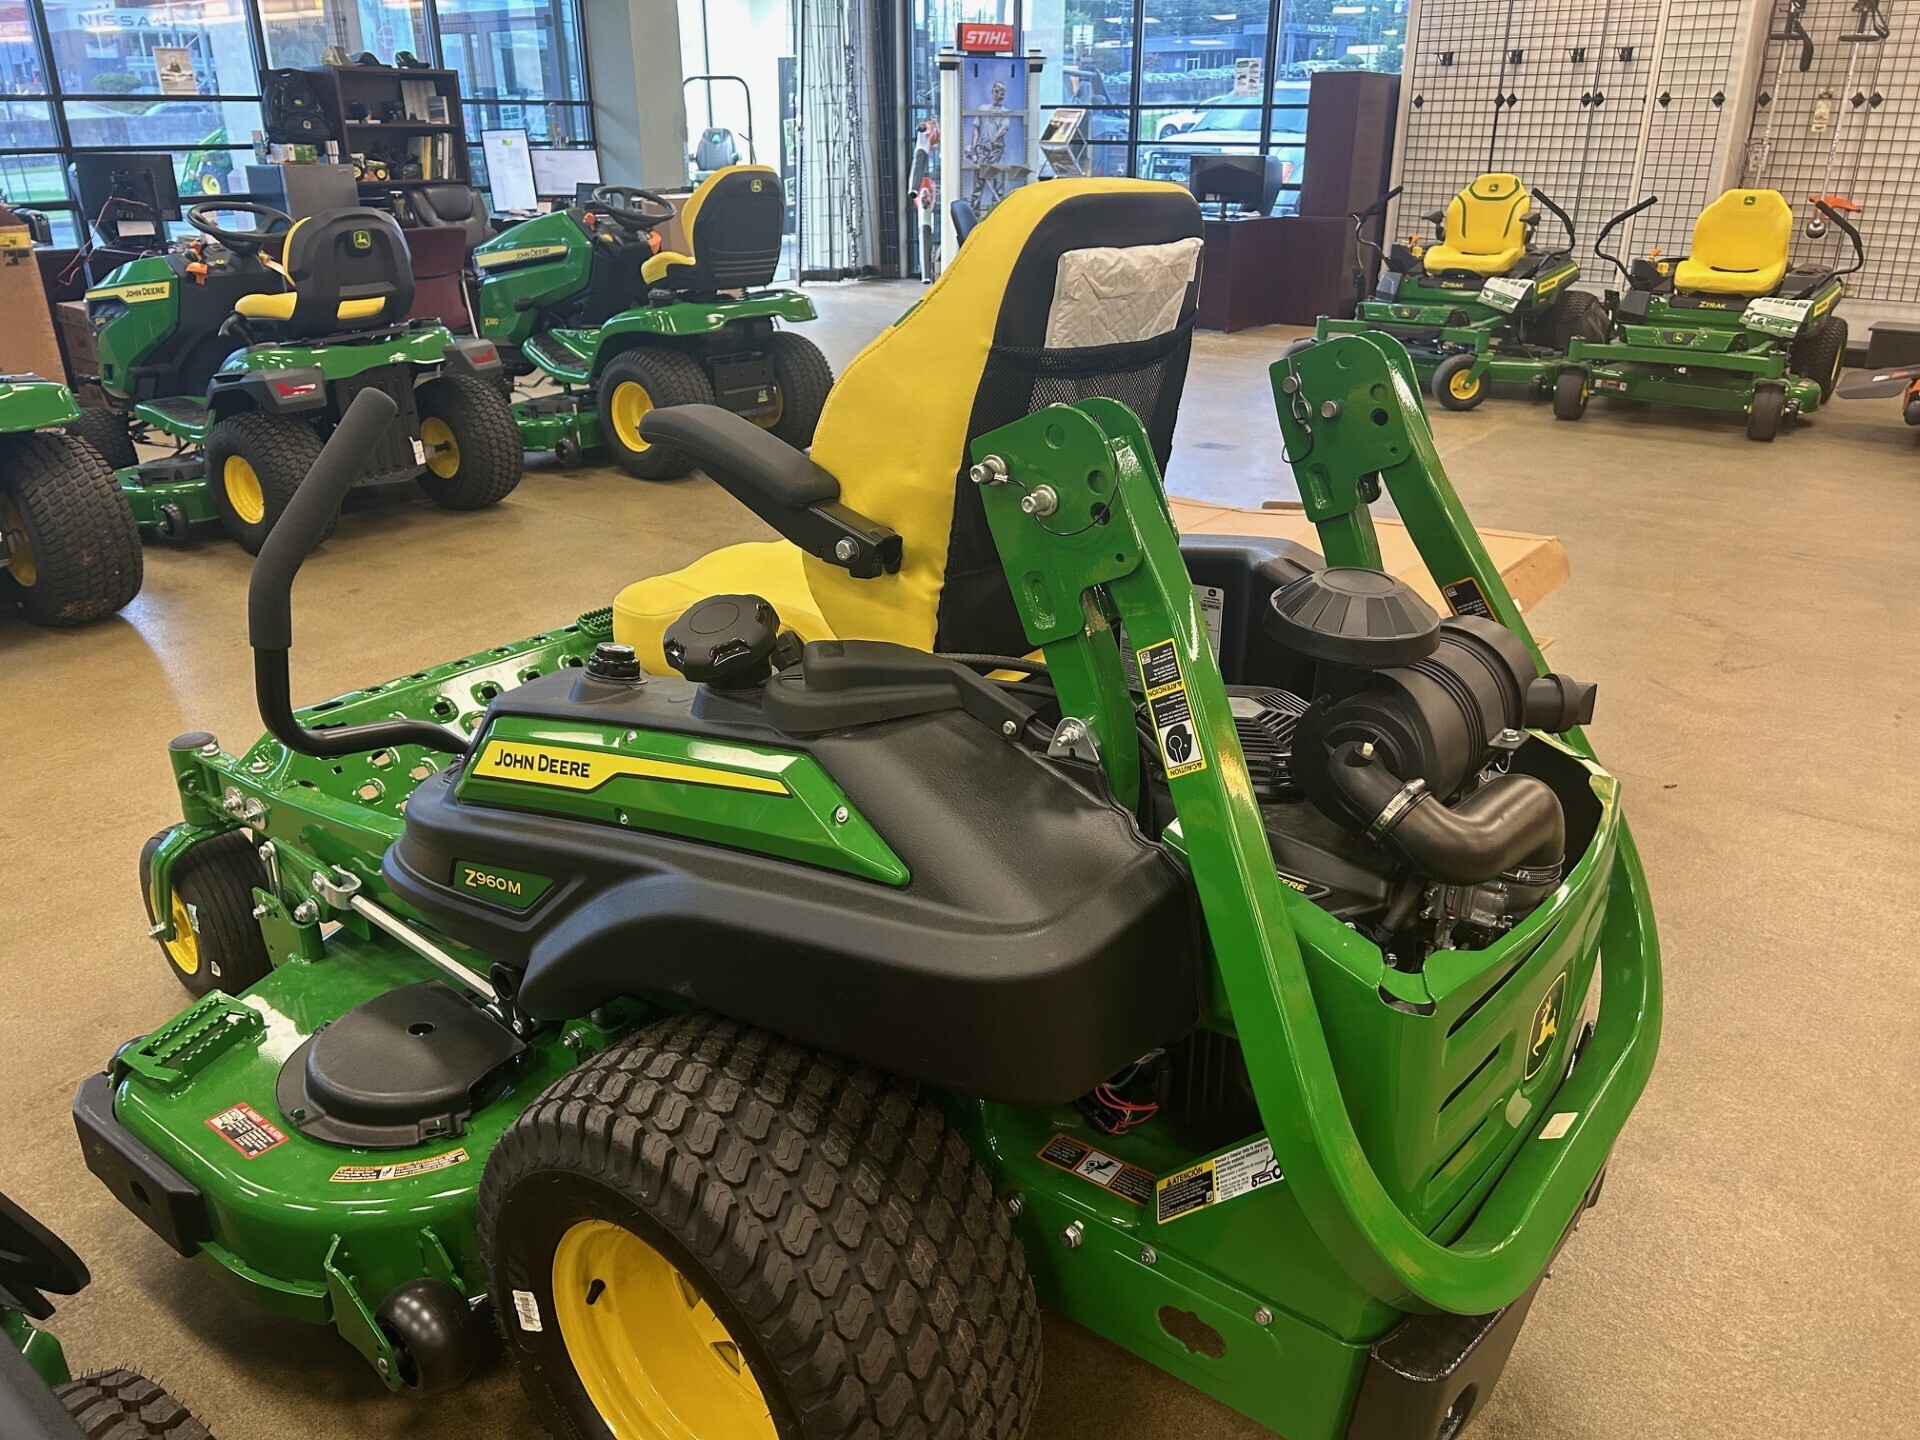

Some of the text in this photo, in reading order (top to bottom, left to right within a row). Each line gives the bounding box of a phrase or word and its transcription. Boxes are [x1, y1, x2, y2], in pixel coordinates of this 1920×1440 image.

[1307, 24, 1338, 33] NISSAN
[965, 30, 1009, 45] STIHL
[515, 247, 550, 261] JOHN DEERE
[1441, 281, 1465, 289] ZTRAK
[125, 286, 165, 298] JOHN DEERE
[1699, 301, 1727, 309] ZTRAK
[494, 748, 590, 778] JOHN DEERE
[1170, 763, 1197, 776] CAUTION
[464, 868, 521, 895] Z960M
[1172, 1166, 1203, 1185] ATENCIÓN
